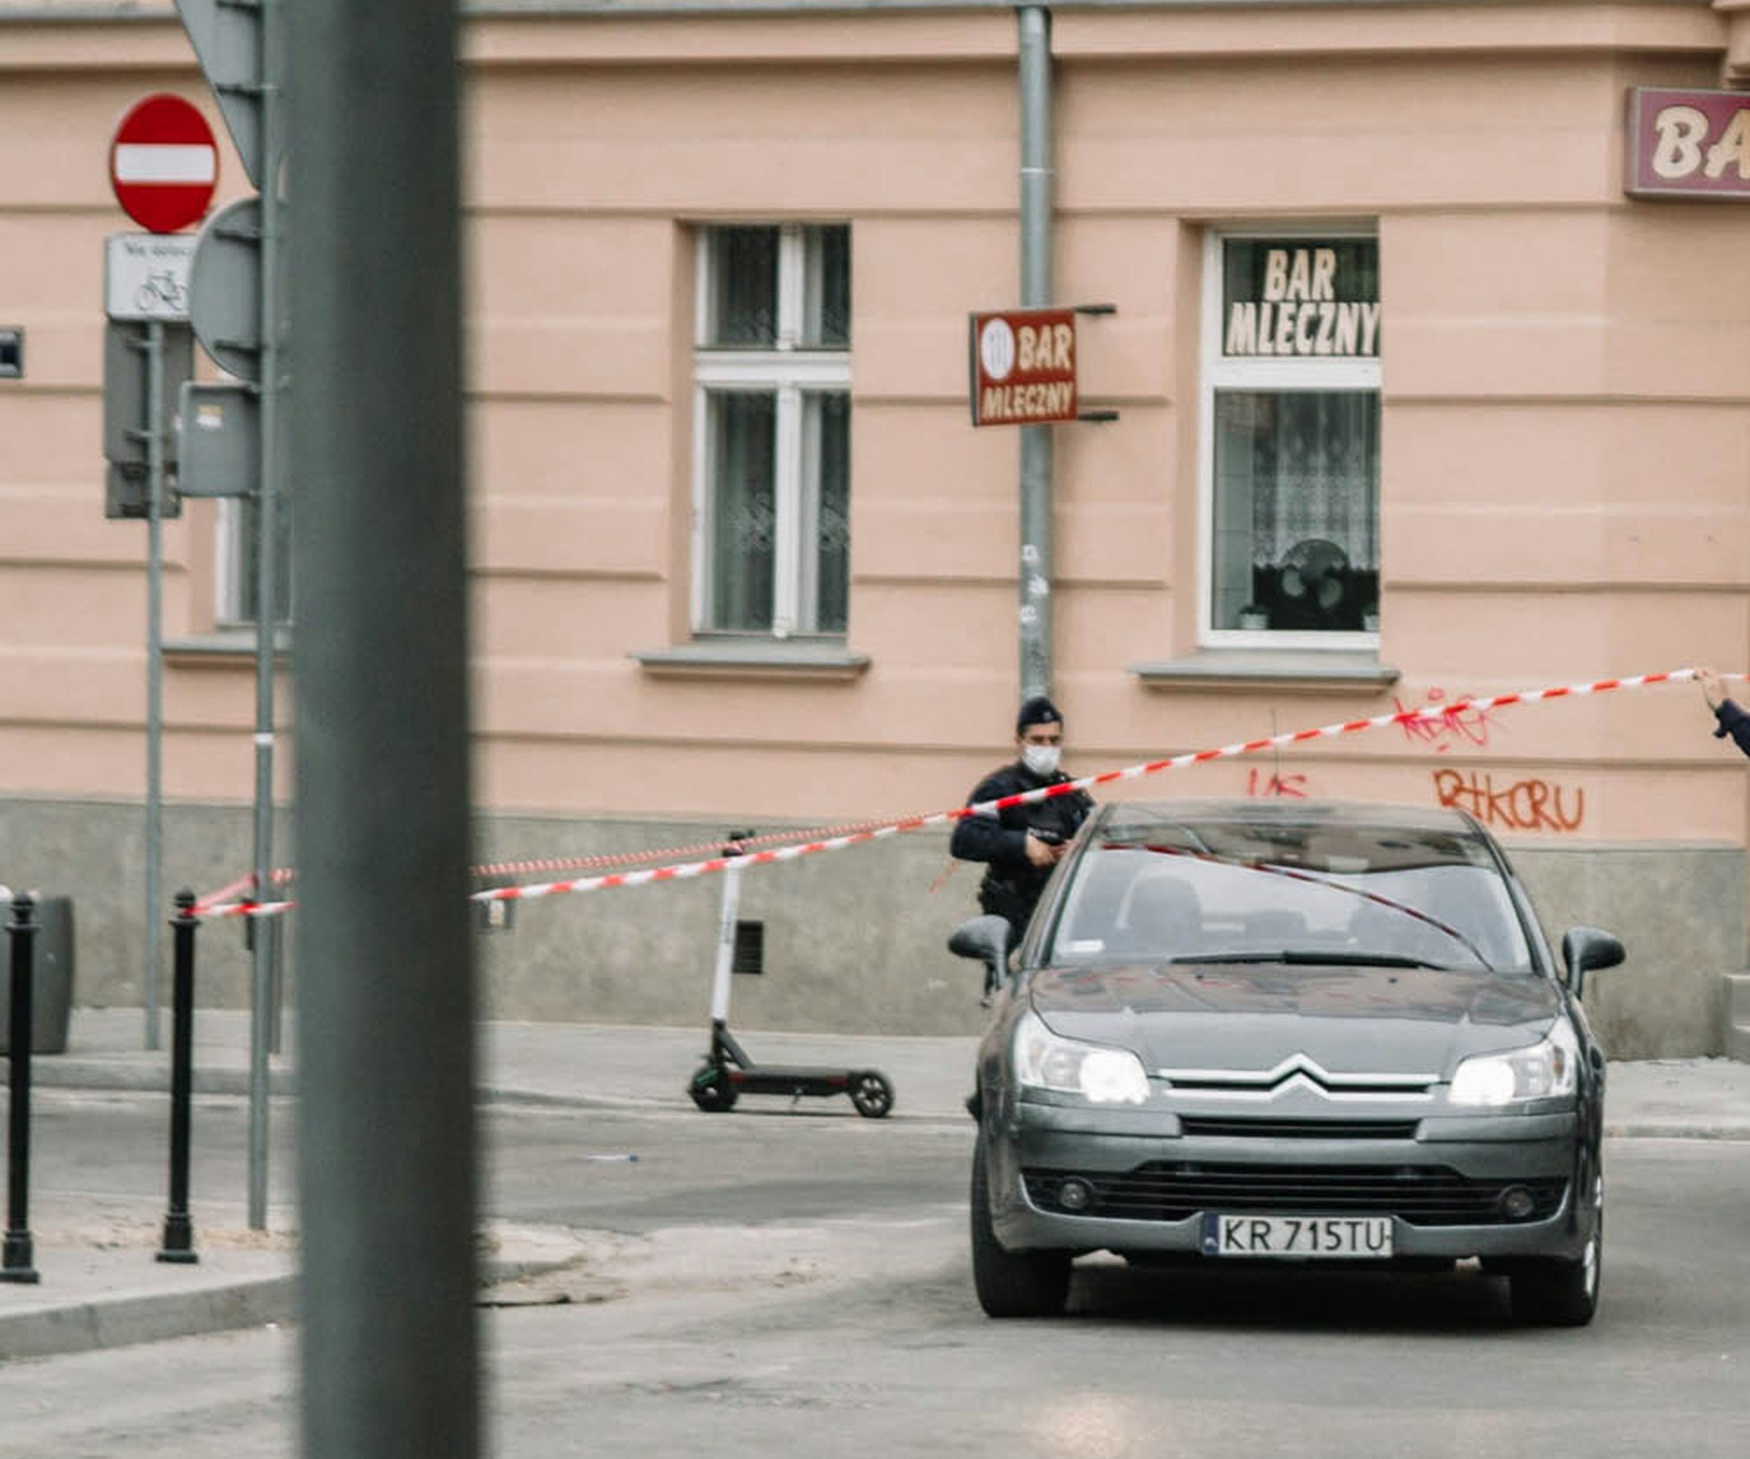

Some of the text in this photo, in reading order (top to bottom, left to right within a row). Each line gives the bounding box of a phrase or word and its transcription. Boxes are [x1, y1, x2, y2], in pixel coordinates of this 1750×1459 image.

[1265, 248, 1336, 302] BAR
[1018, 323, 1072, 372] BAR
[1226, 302, 1381, 354] MLECZNY
[981, 381, 1074, 419] MLECZNY
[1224, 1218, 1386, 1252] KR 715TU
